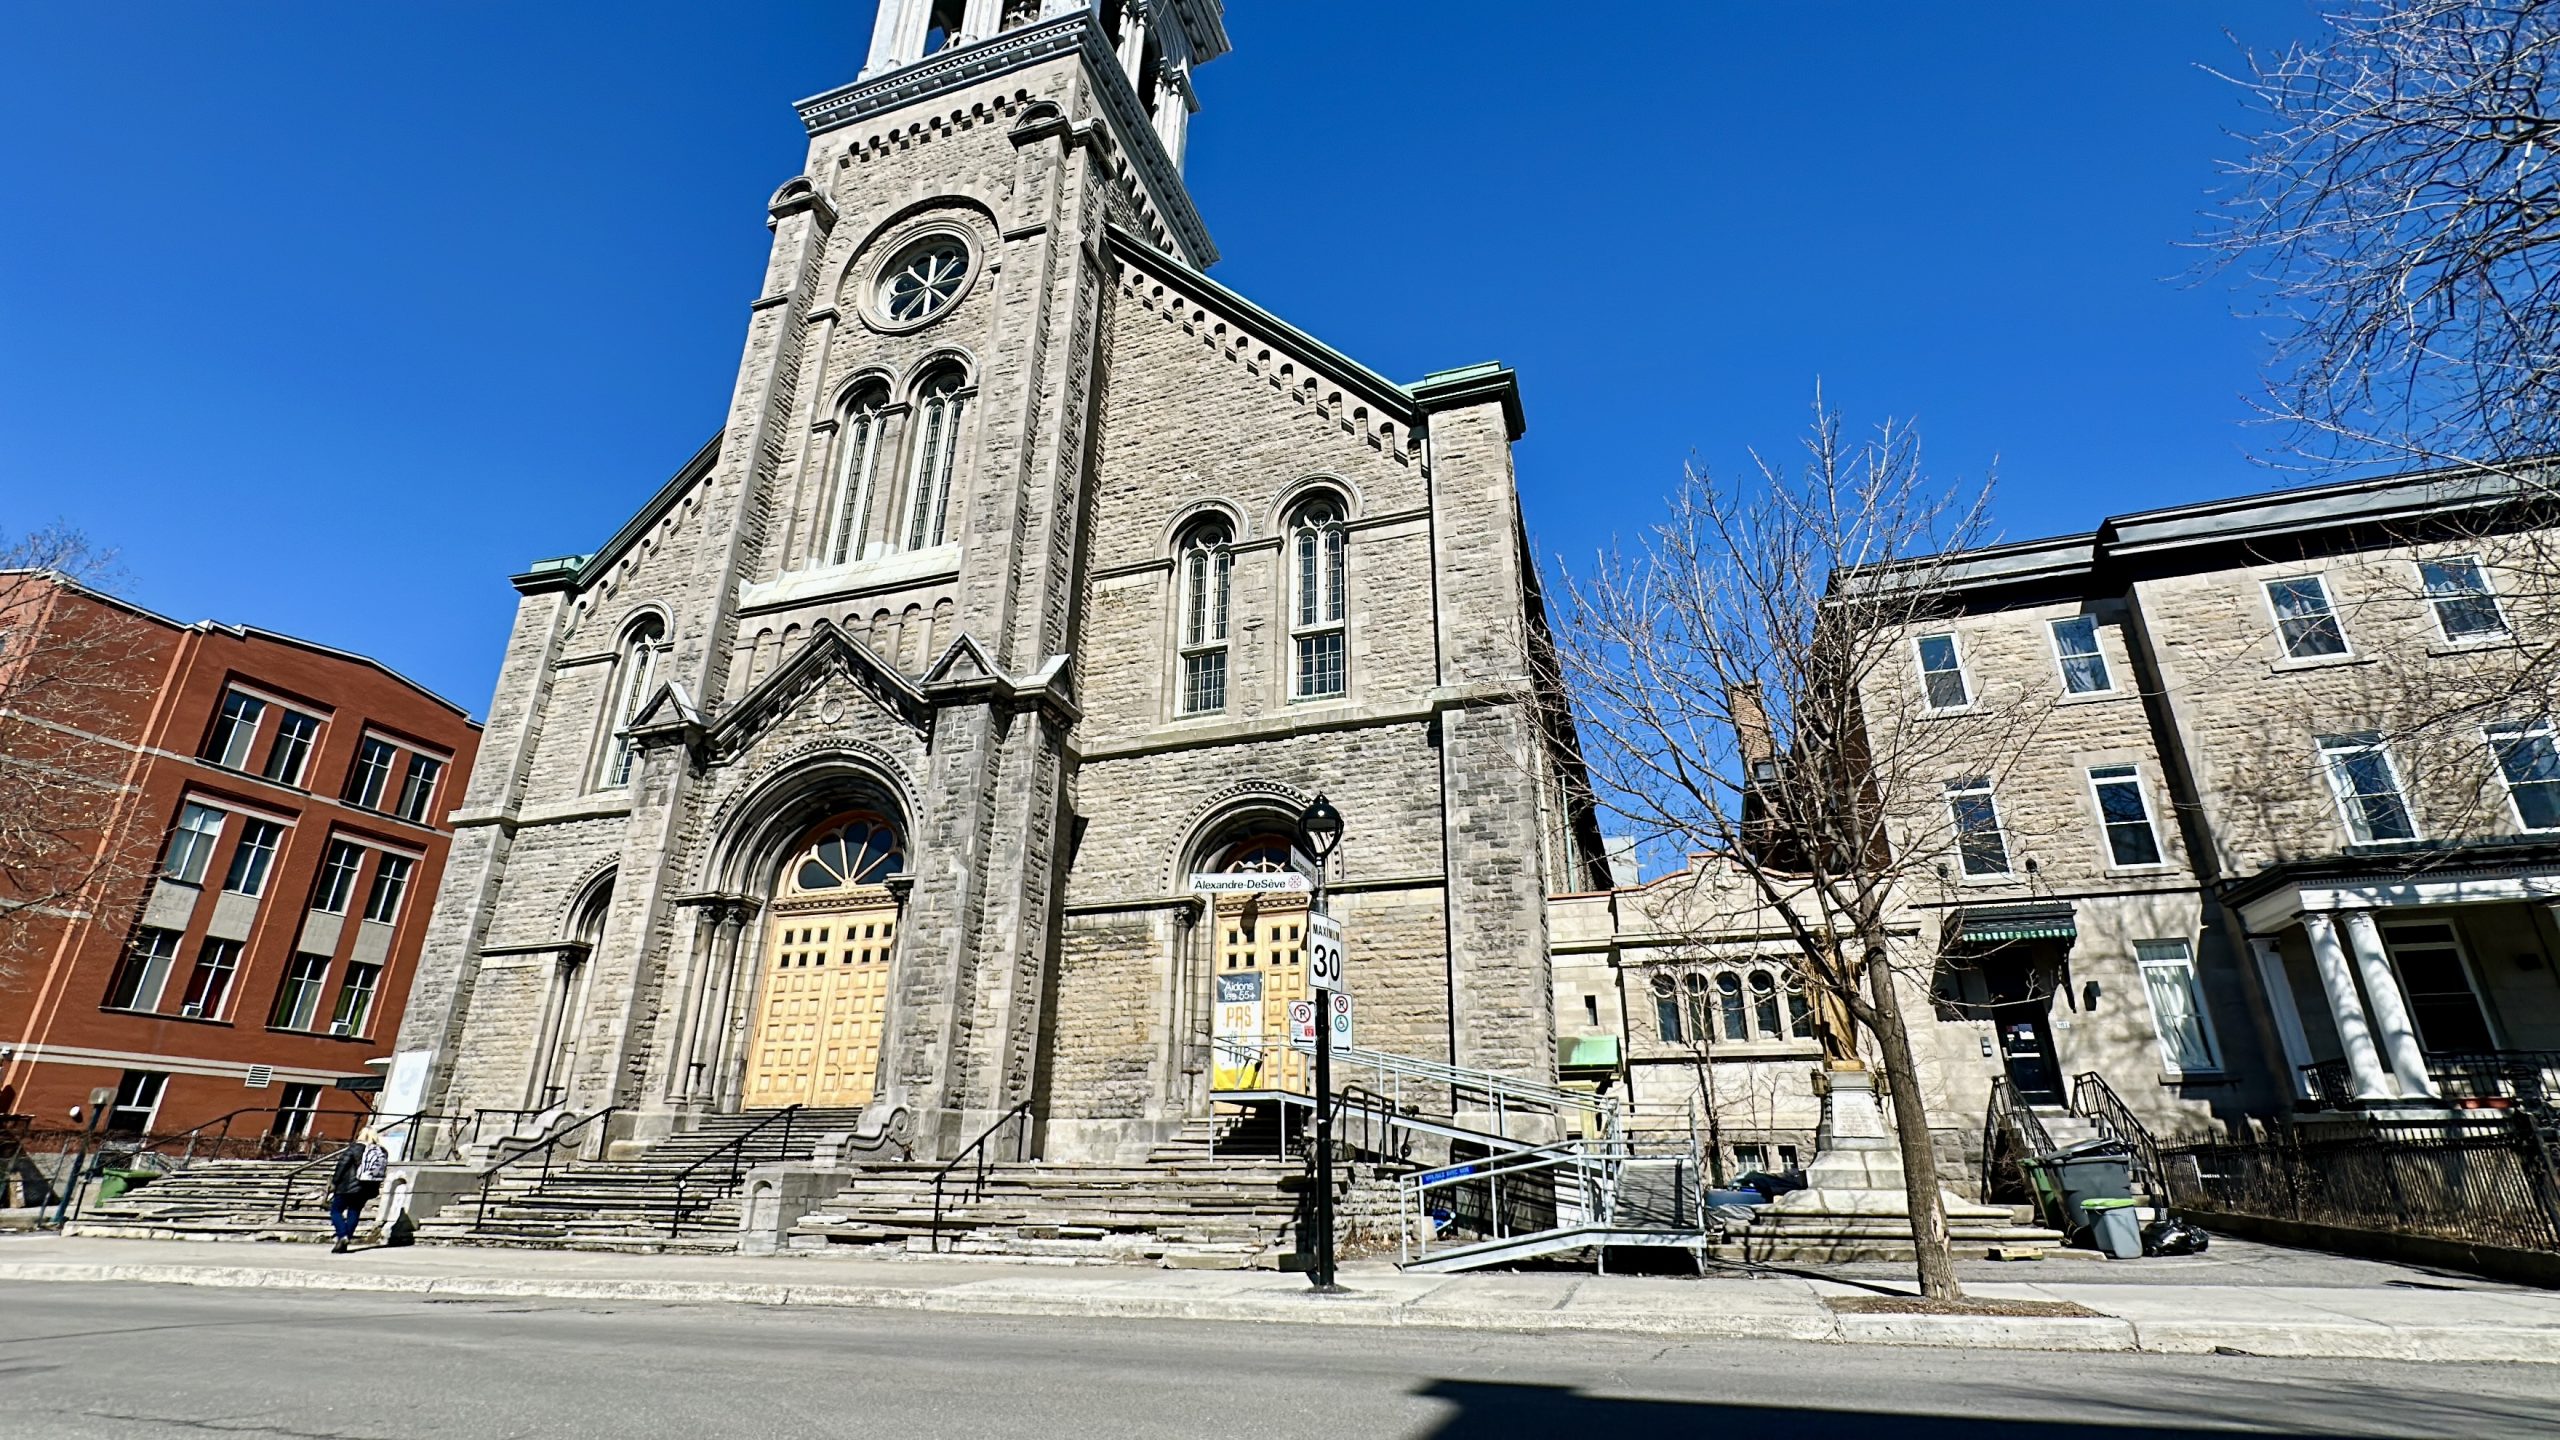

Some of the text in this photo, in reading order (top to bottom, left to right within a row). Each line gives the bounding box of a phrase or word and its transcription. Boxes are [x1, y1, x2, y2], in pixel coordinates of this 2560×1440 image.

[1194, 879, 1286, 889] Alexandre-DeSève
[1312, 923, 1340, 941] MAXIMUM
[1313, 944, 1340, 982] 30
[1224, 981, 1254, 991] Aidons
[1239, 990, 1256, 1000] 55+
[1226, 1005, 1252, 1028] PAS
